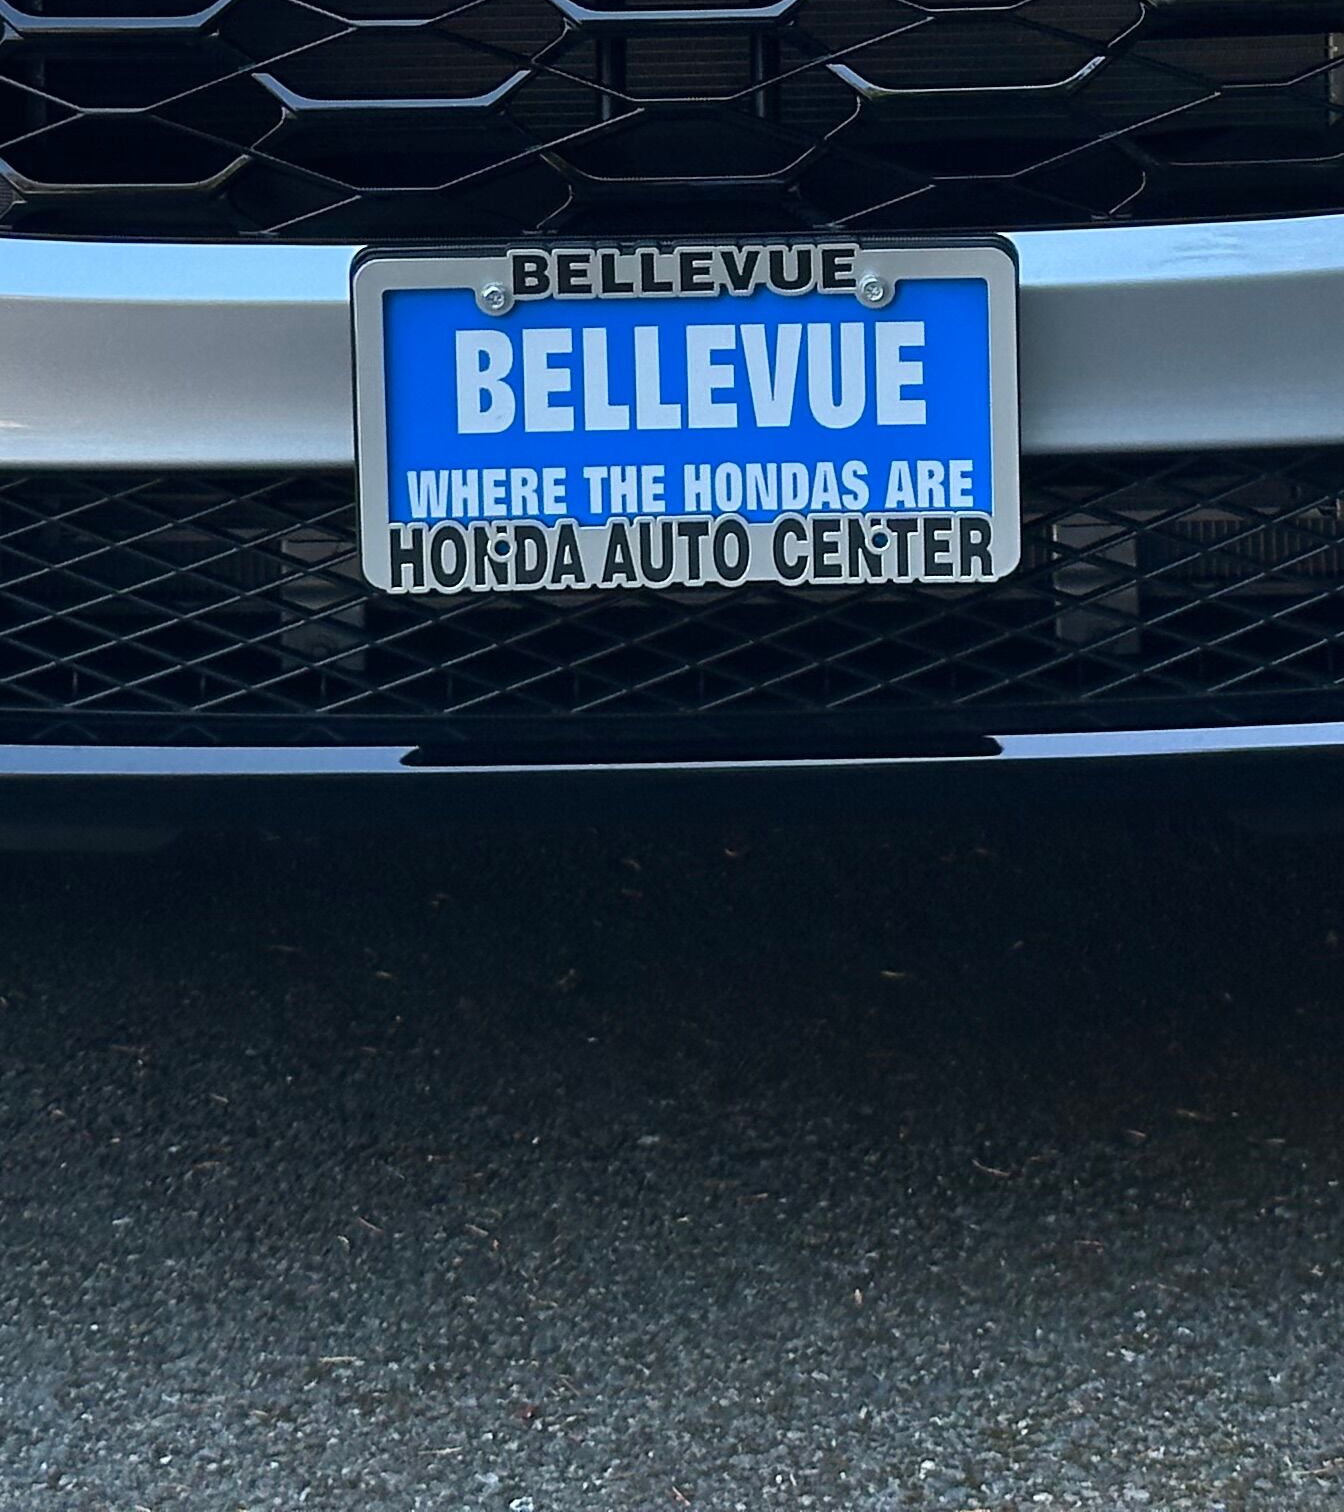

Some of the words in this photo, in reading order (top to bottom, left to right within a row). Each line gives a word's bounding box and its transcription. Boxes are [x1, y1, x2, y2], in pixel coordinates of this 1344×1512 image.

[511, 247, 856, 295] BELLEVUE
[455, 320, 927, 435] BELLEVUE
[406, 466, 567, 519] WHERE
[583, 464, 666, 514] THE
[684, 460, 870, 513] HONDAS
[885, 458, 974, 509] ARE
[388, 522, 585, 589] HONDA
[601, 518, 750, 584] AUTO
[772, 515, 994, 581] CENTER
